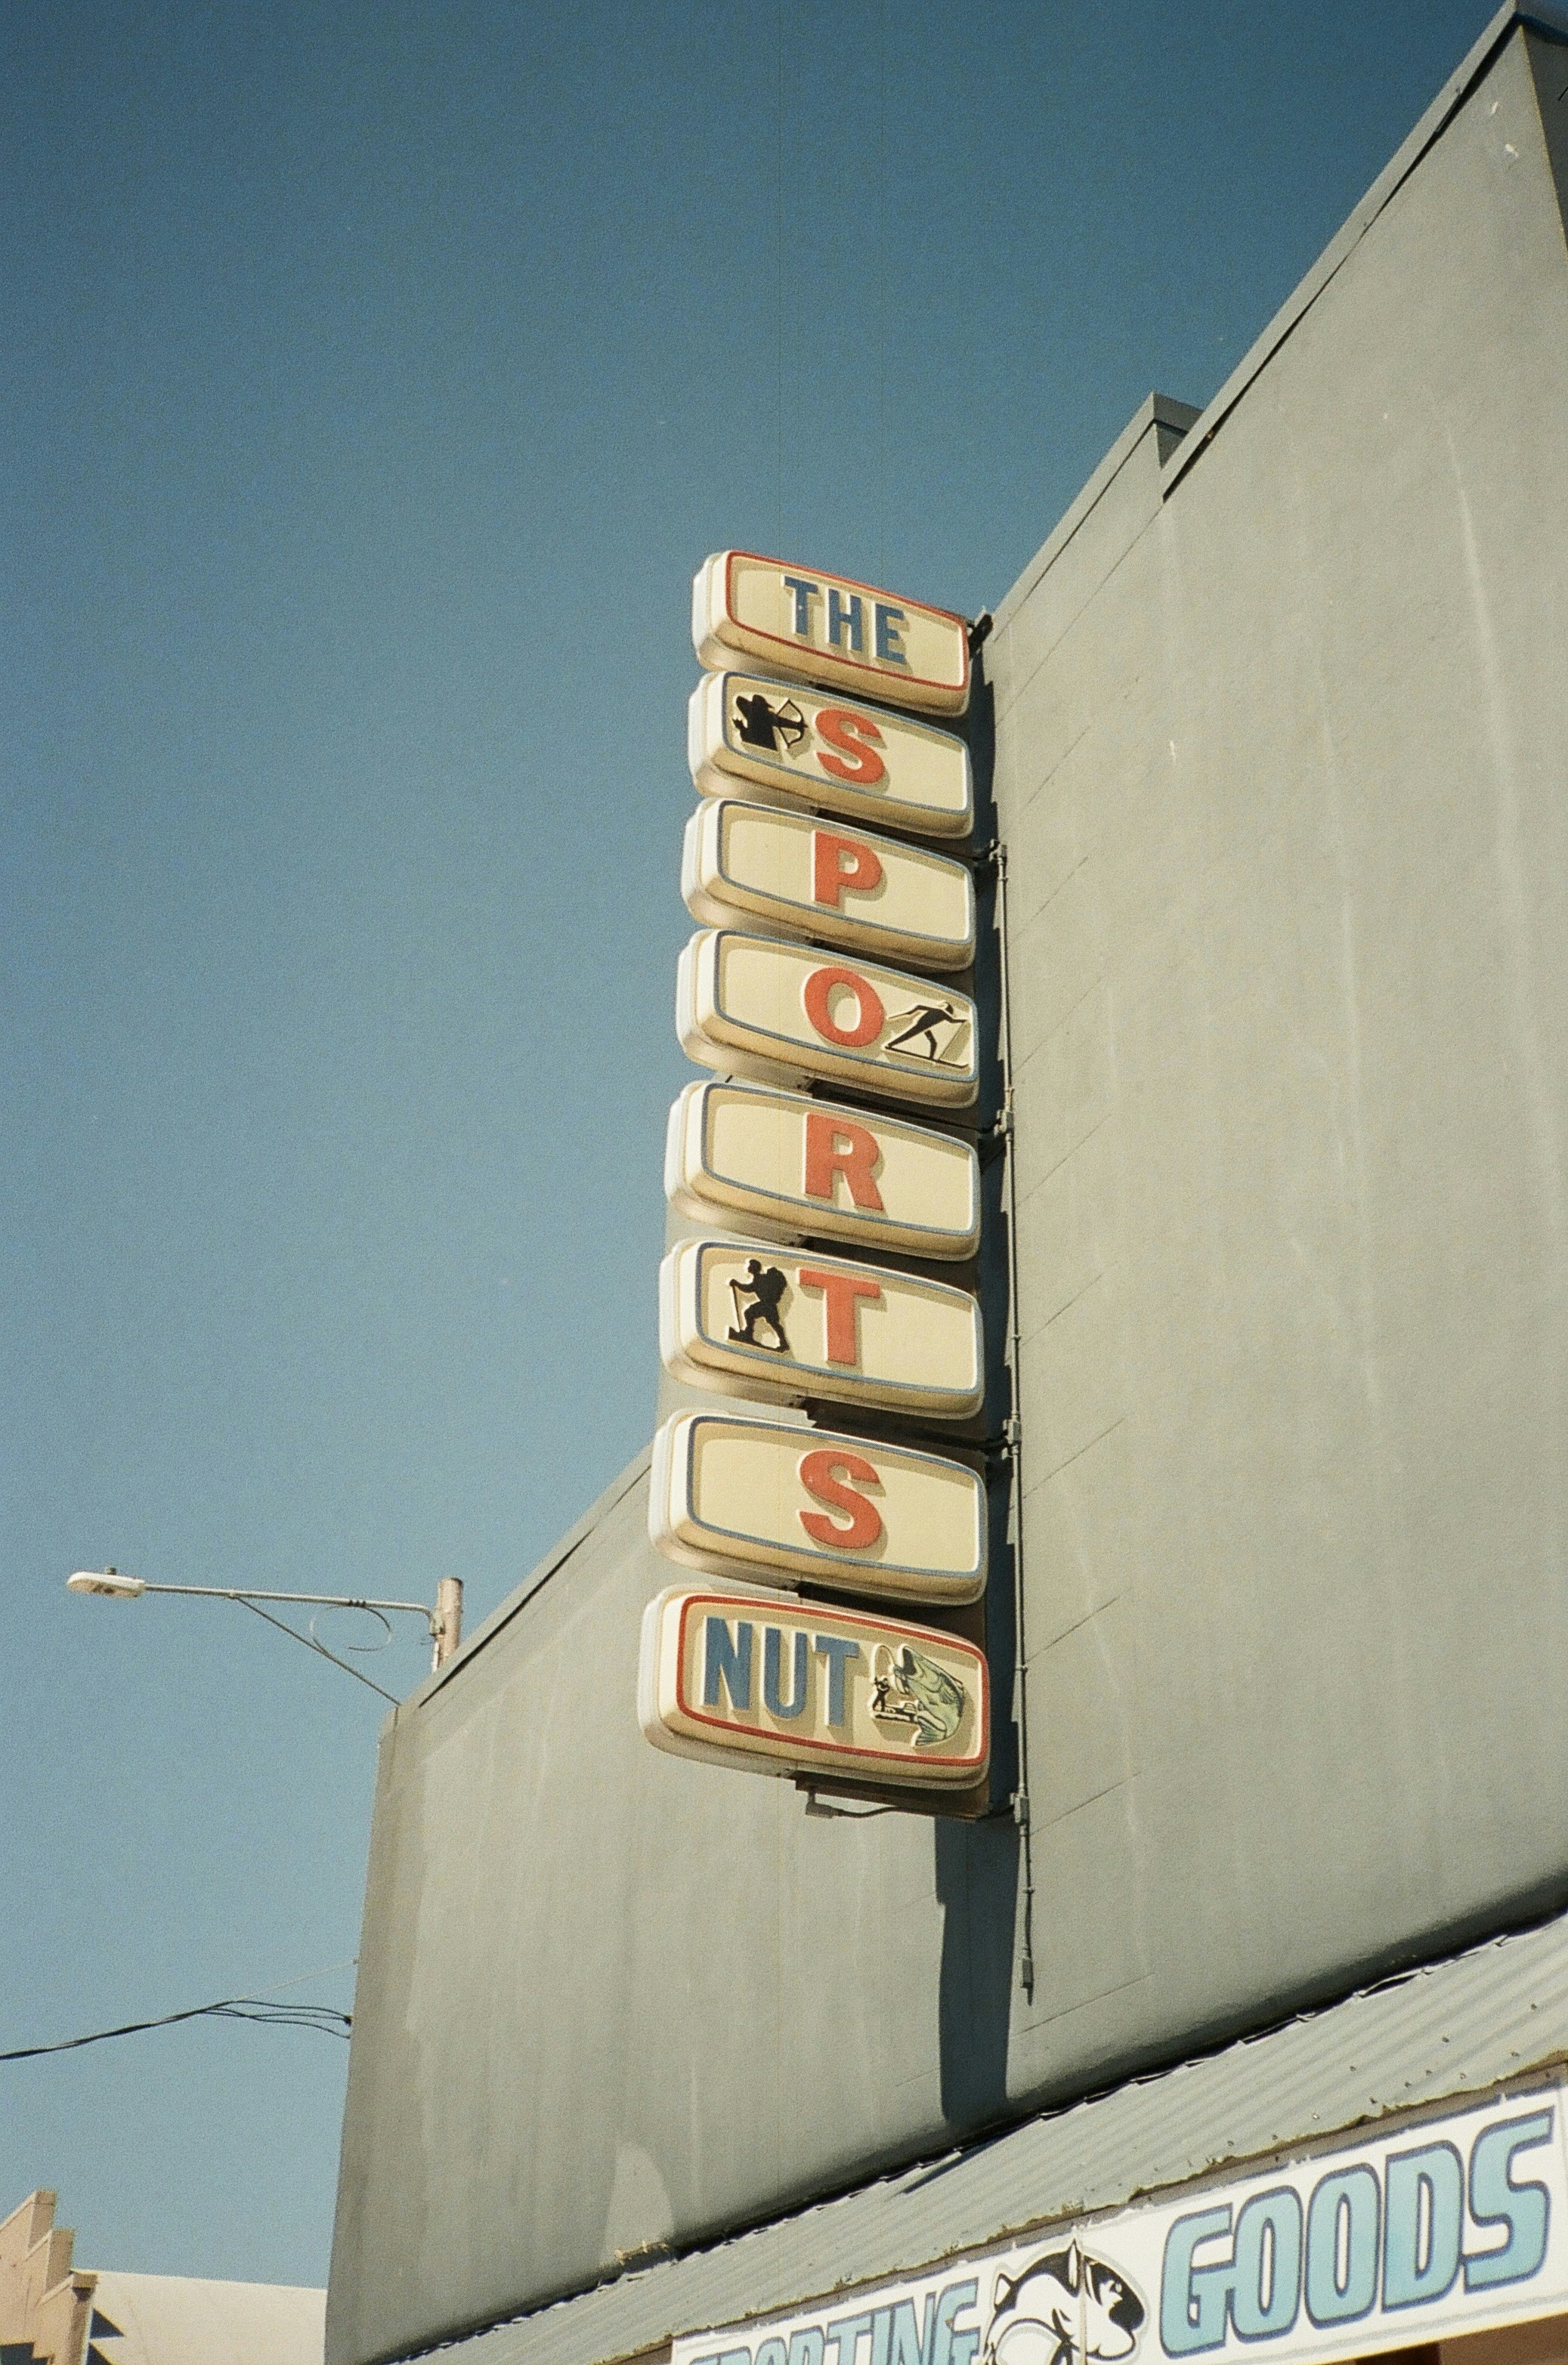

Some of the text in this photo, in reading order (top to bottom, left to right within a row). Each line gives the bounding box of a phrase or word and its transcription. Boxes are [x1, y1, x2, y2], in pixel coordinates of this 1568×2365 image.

[784, 575, 905, 665] THE
[798, 708, 886, 1549] SPORTS
[703, 1615, 860, 1727] NUT
[1159, 2104, 1555, 2359] GOODS
